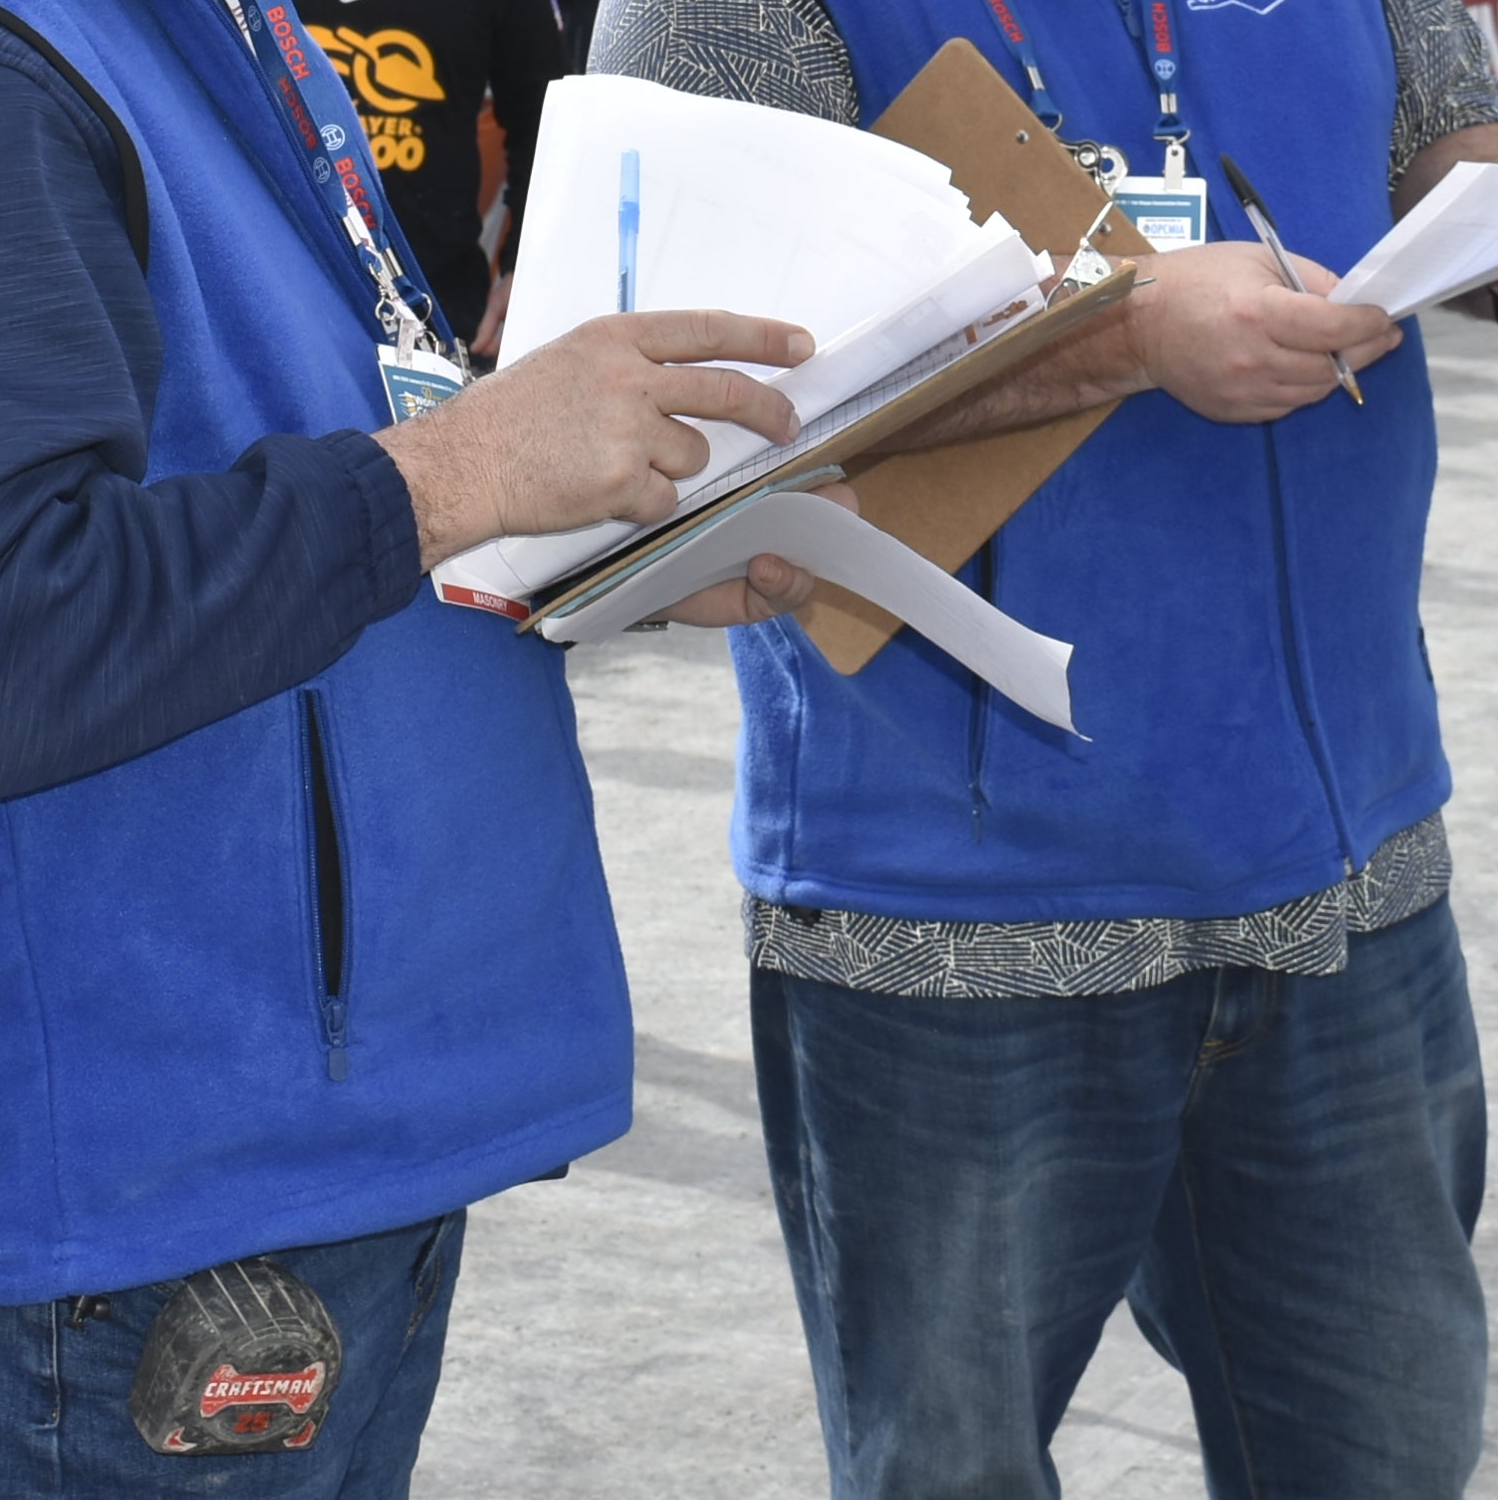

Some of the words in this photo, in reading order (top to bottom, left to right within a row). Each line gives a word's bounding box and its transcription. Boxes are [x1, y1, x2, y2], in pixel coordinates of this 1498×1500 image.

[266, 5, 312, 80] BOSCH
[1152, 1, 1173, 53] BOSCH
[369, 135, 426, 172] 00
[334, 155, 378, 230] BOSCH
[472, 591, 508, 612] MASONRY
[204, 1377, 316, 1398] CRAFTSMAN
